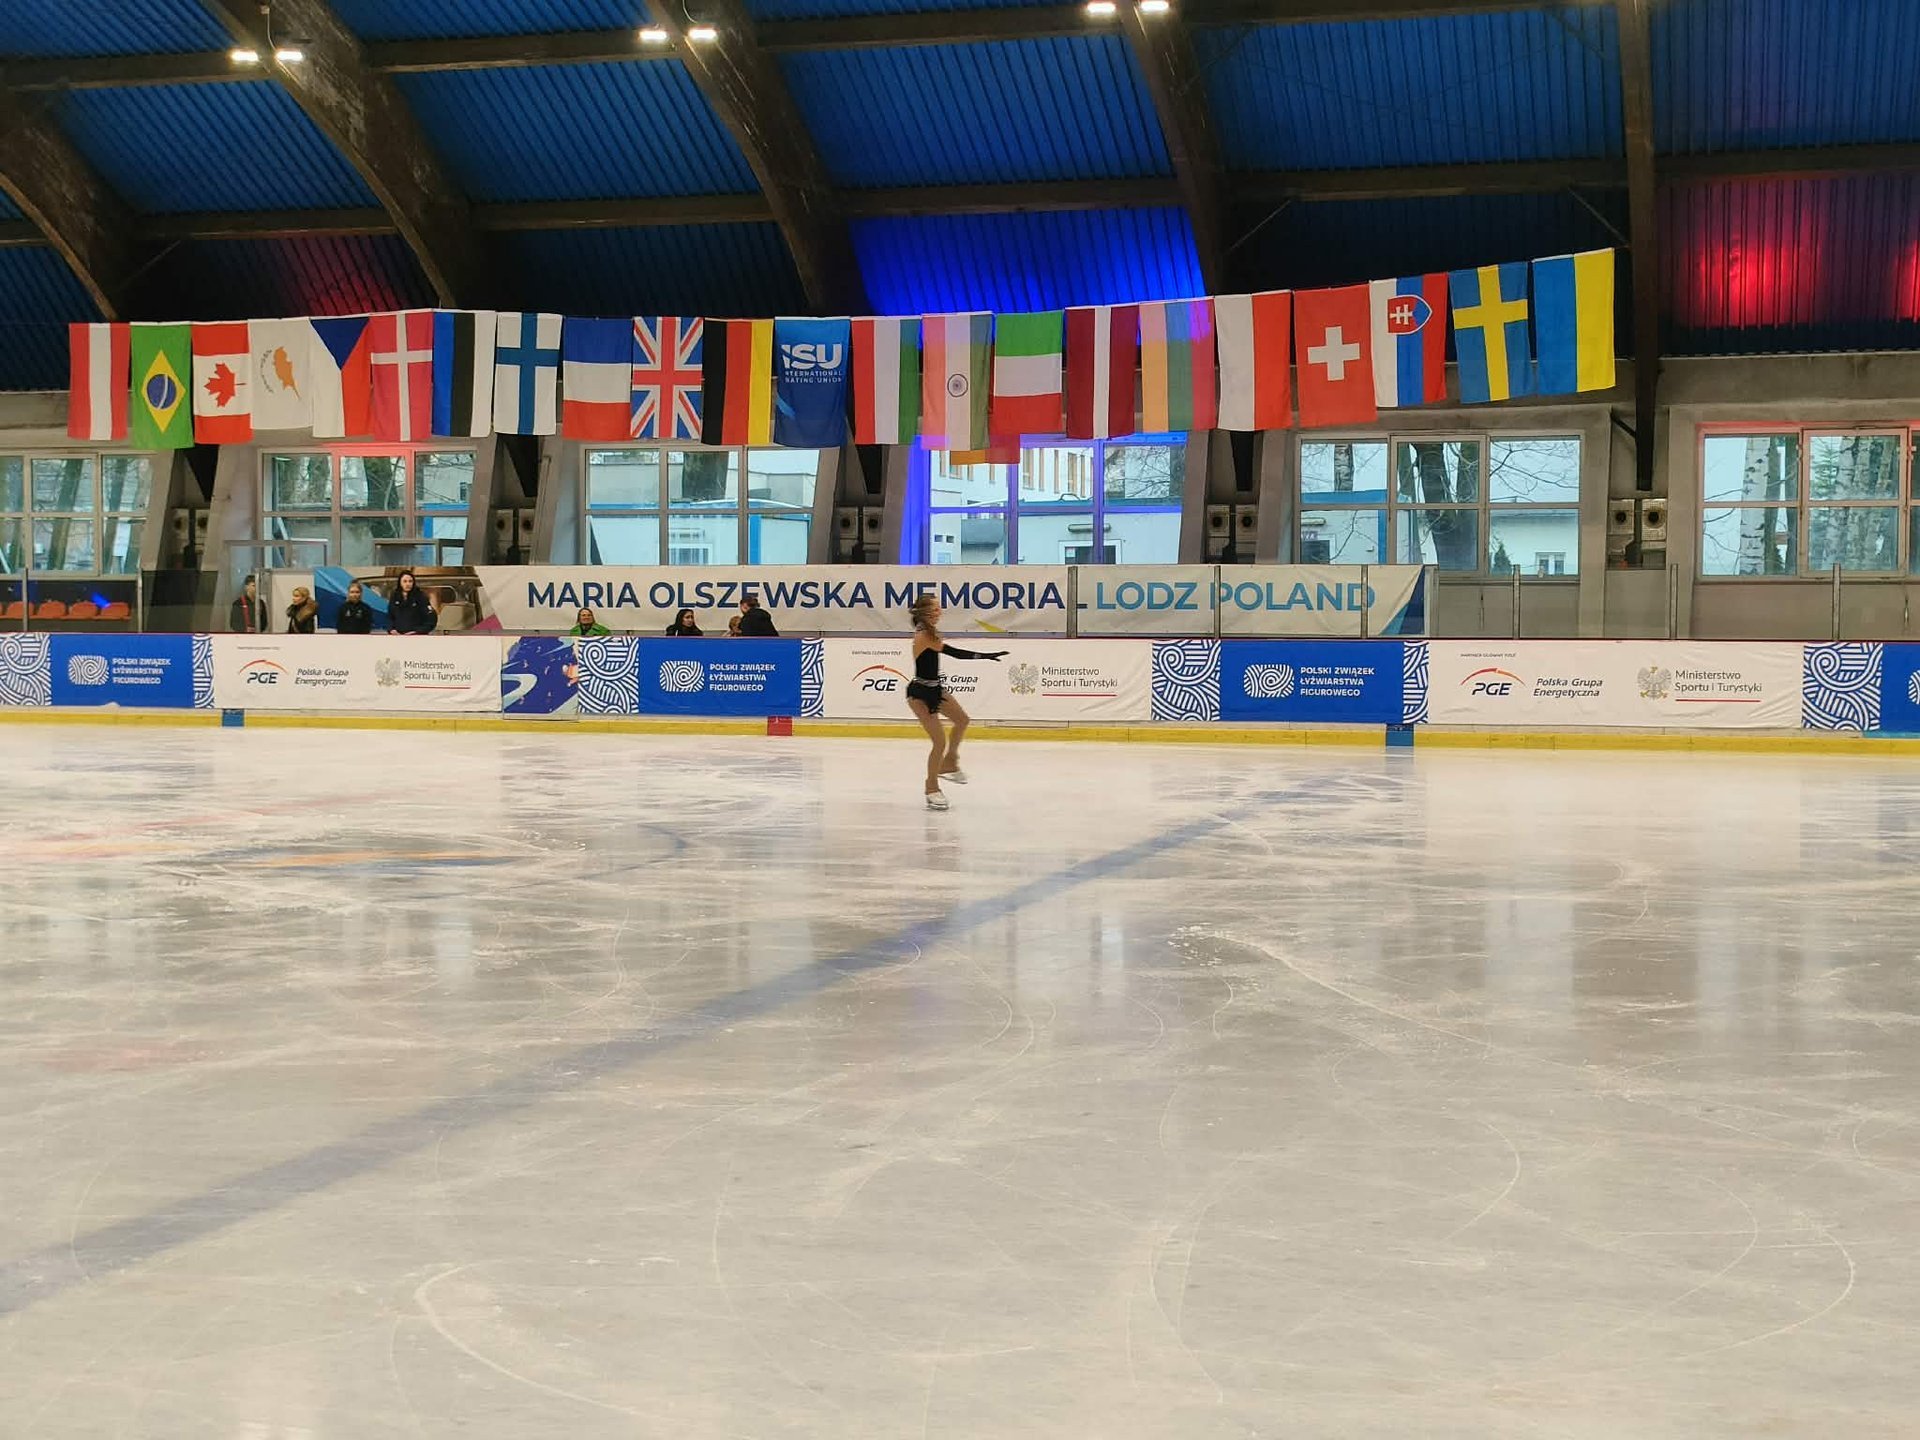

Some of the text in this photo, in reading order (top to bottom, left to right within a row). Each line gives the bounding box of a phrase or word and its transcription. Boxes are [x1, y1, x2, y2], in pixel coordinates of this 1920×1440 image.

[780, 343, 843, 370] ISU
[527, 581, 641, 609] MARIA
[649, 581, 875, 609] OLSZEWSKA
[1096, 581, 1199, 611] LODZ
[1209, 582, 1376, 612] POLAND
[403, 660, 456, 670] Ministerstwo
[709, 663, 776, 674] POLSKI ZWIĄZEK
[296, 667, 350, 678] Polska Grupa
[403, 671, 430, 681] Sportu
[437, 671, 472, 682] Turystyki
[1041, 666, 1100, 676] Ministerstwo
[1300, 666, 1375, 678] POLSKI ZWIĄZEK
[1674, 669, 1741, 680] Ministerstwo
[246, 672, 279, 684] PGE
[294, 677, 347, 687] Energetyczna
[950, 674, 979, 685] Grupa
[1041, 677, 1072, 688] Sportu
[1079, 677, 1119, 689] Turystyki
[1536, 677, 1603, 689] Polska Grupa
[709, 683, 764, 692] FIGUROWEGO
[861, 678, 899, 692] PGE
[1471, 682, 1513, 696] PGE
[1674, 681, 1709, 693] Sportu
[1718, 682, 1763, 694] Turystyki
[1300, 688, 1361, 697] FIGUROWEGO
[1533, 687, 1600, 699] Energetyczna
